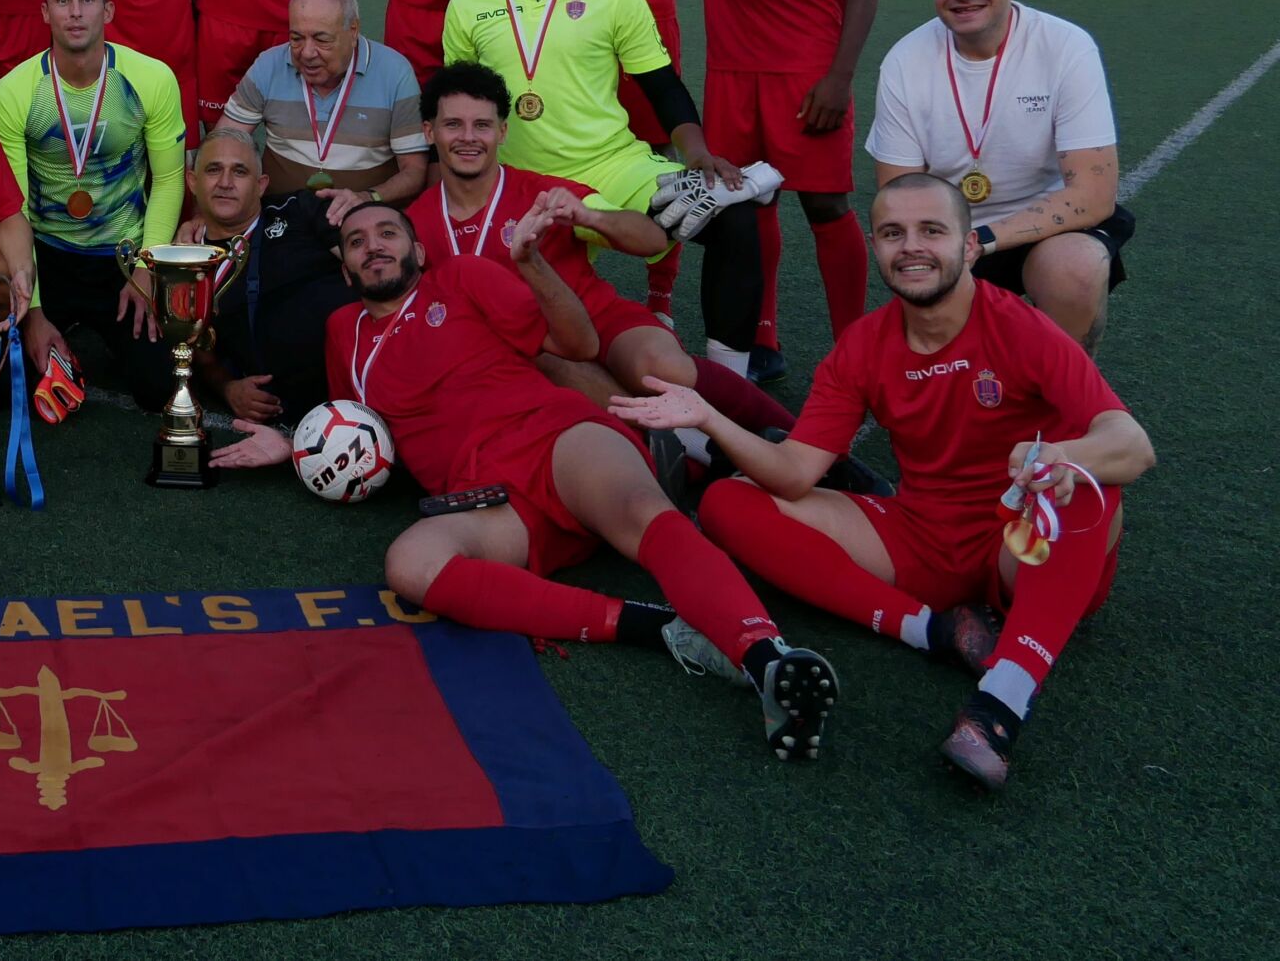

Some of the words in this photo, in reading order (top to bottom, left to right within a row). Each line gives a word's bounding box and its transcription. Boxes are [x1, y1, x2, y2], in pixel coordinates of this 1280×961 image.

[1016, 95, 1050, 104] TOMMY
[905, 359, 969, 380] GIVOVA
[311, 435, 367, 492] Zeus
[1017, 634, 1054, 666] Joma
